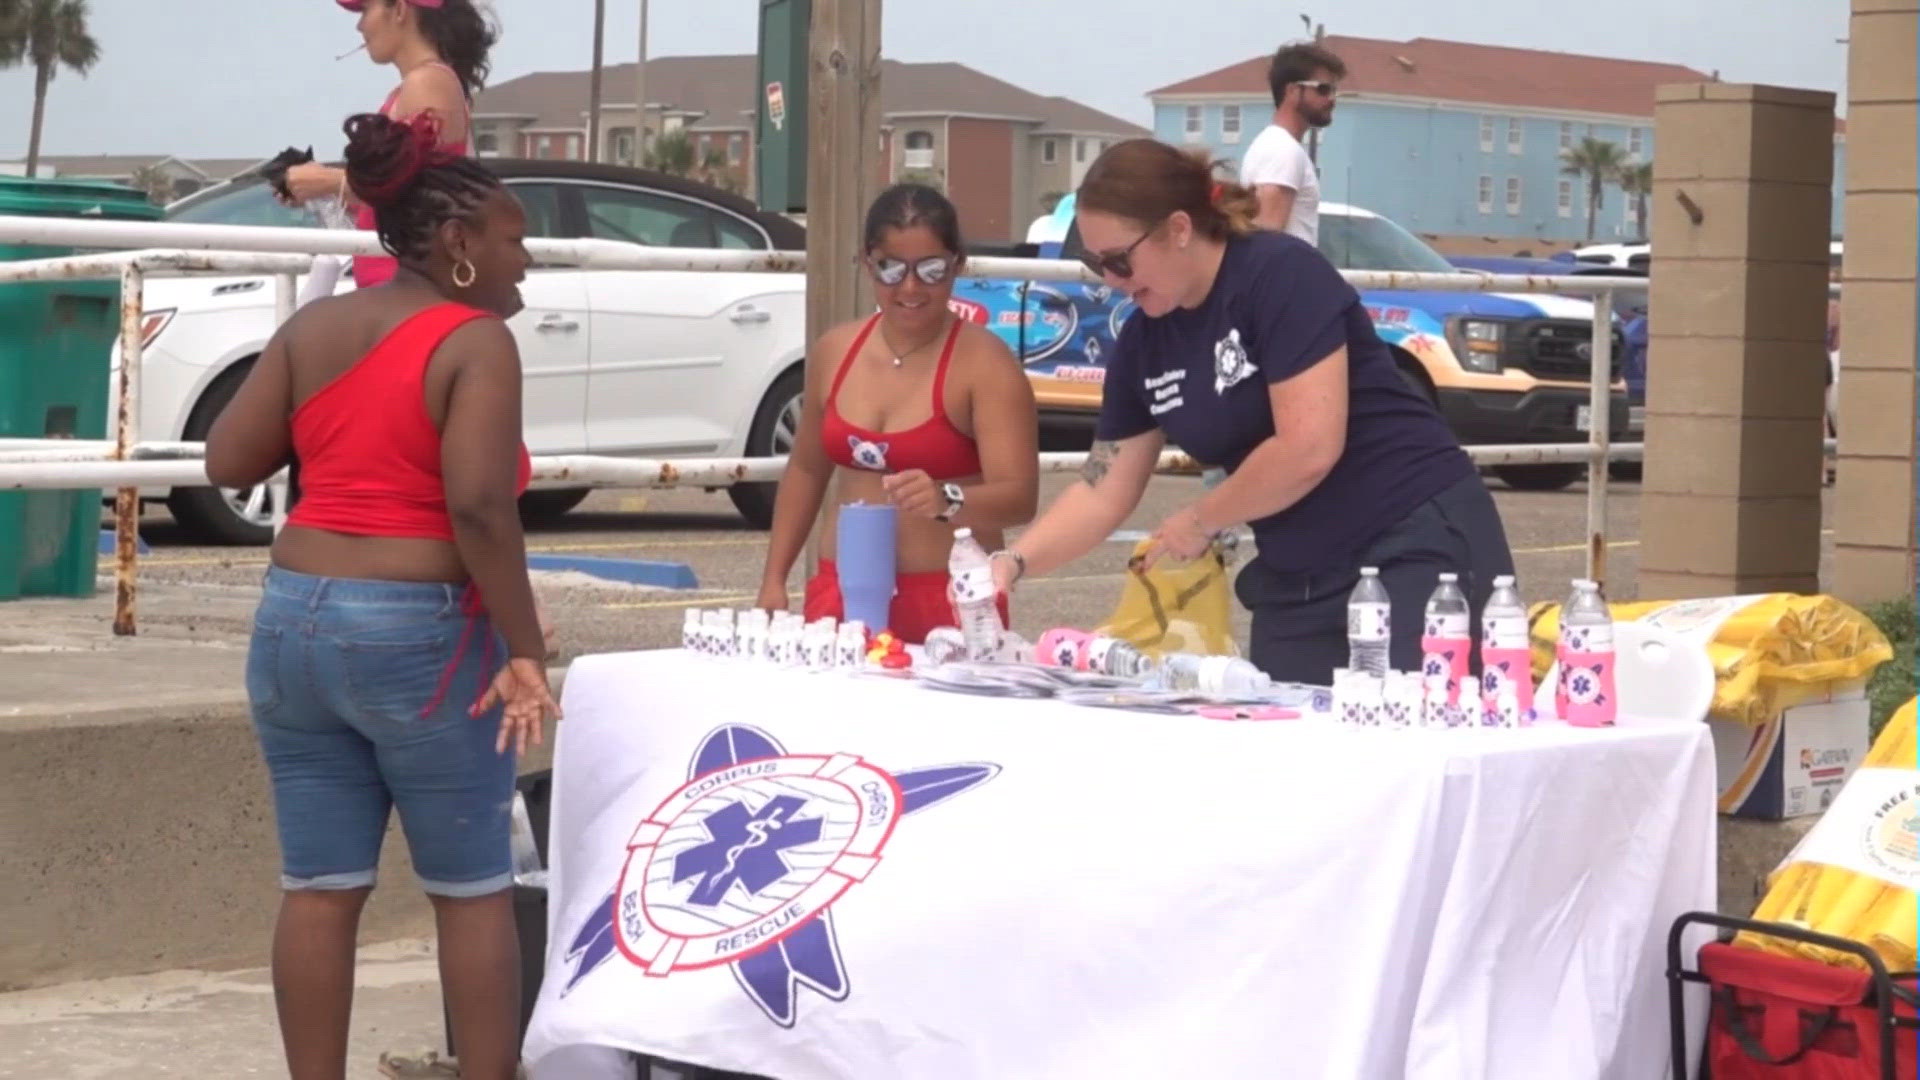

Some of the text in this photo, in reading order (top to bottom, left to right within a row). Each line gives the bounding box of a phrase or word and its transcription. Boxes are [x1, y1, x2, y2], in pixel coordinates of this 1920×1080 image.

[684, 762, 778, 800] CORPUS
[1875, 790, 1908, 819] FREE
[622, 890, 806, 955] BEACH RESCUE
